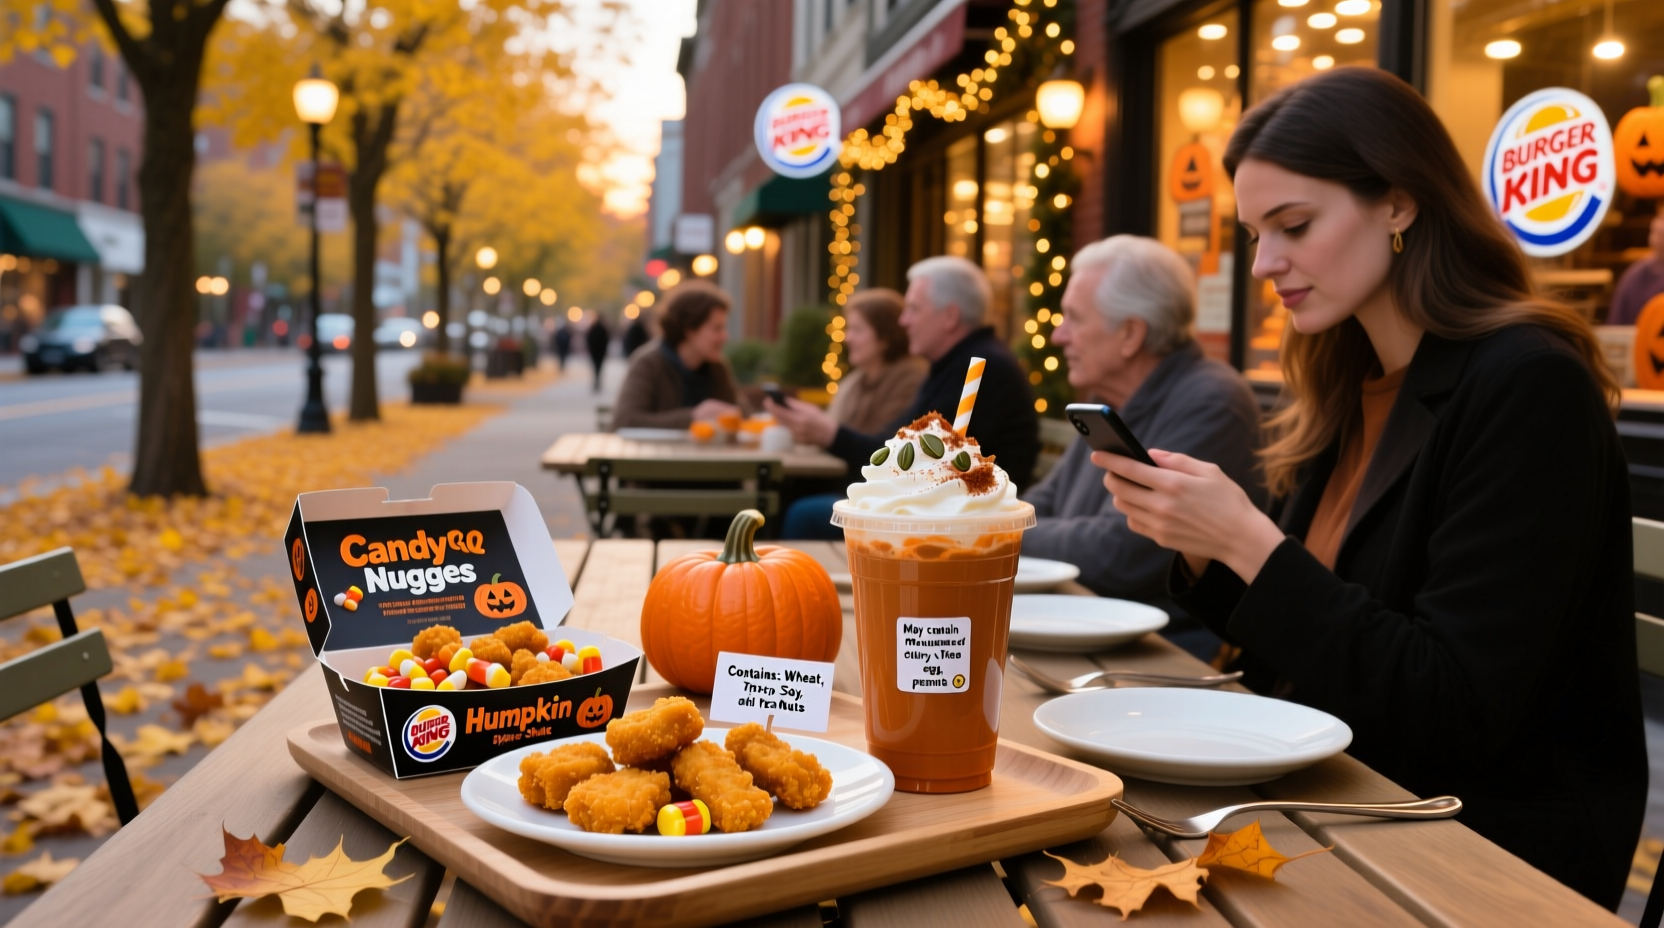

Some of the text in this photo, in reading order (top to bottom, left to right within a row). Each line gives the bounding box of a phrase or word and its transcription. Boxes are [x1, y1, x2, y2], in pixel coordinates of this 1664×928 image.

[773, 124, 829, 150] KING
[1502, 122, 1596, 174] BURGER
[1502, 149, 1598, 213] KING
[364, 563, 477, 595] Nugges
[903, 623, 923, 638] May
[728, 665, 824, 687] Contains: Wheat,
[779, 685, 803, 701] Soy,
[465, 695, 572, 732] Humpkin
